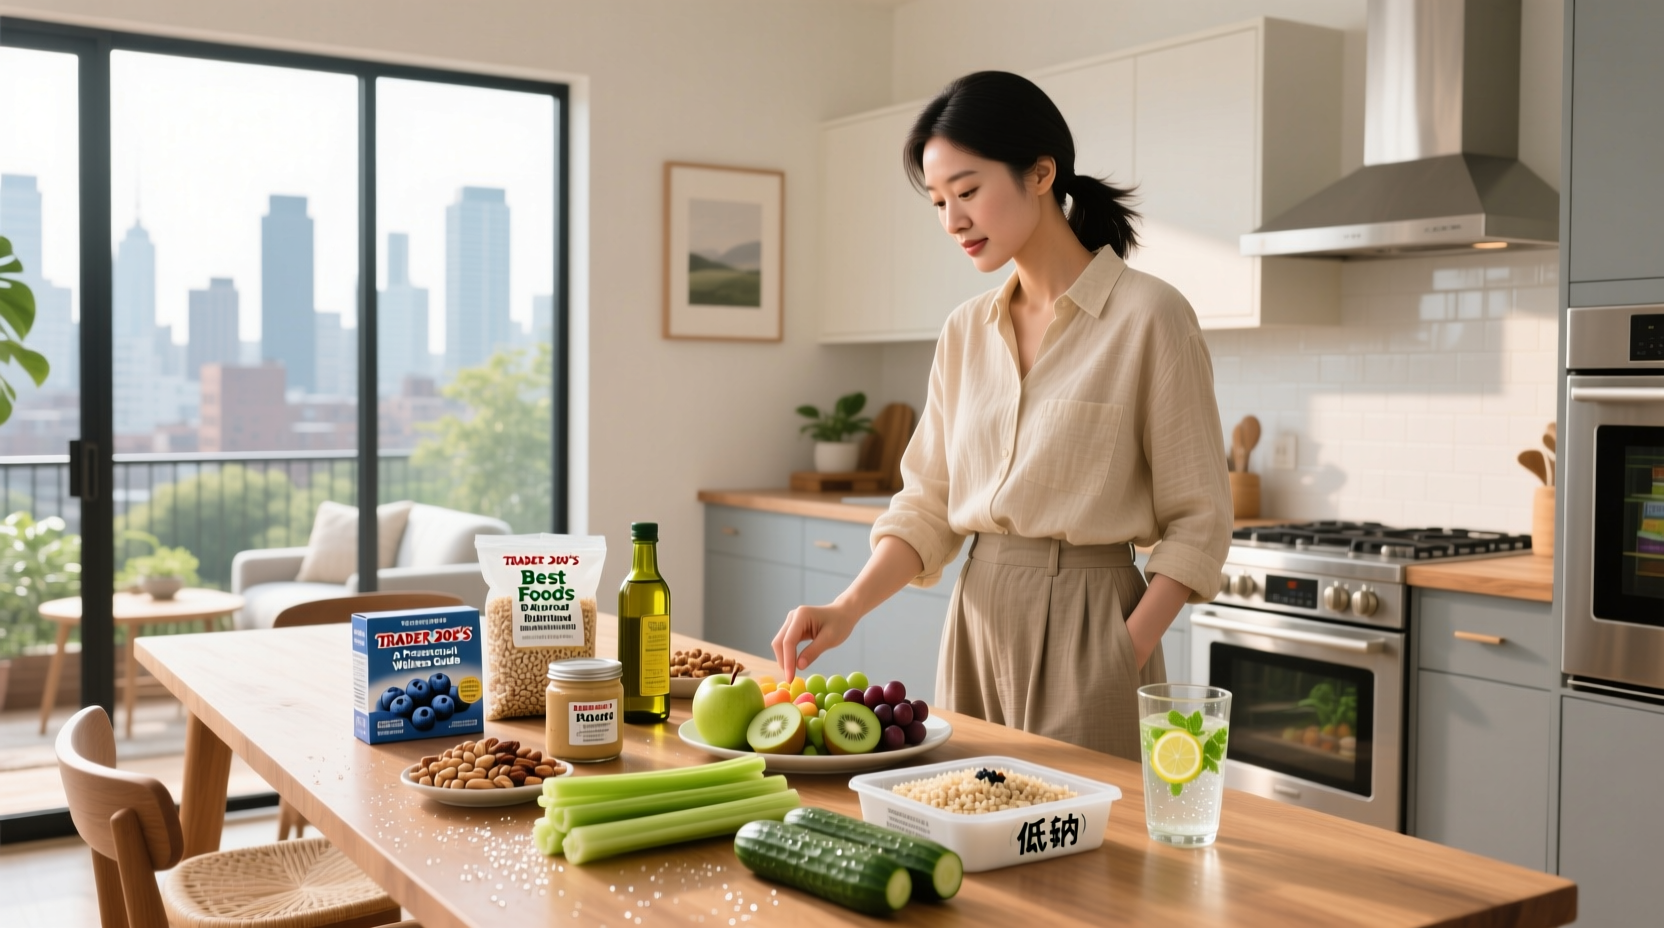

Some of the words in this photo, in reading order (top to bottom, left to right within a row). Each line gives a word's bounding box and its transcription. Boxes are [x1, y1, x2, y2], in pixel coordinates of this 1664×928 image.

[520, 570, 566, 585] Best
[518, 586, 575, 602] Foods
[376, 631, 431, 648] TRADER
